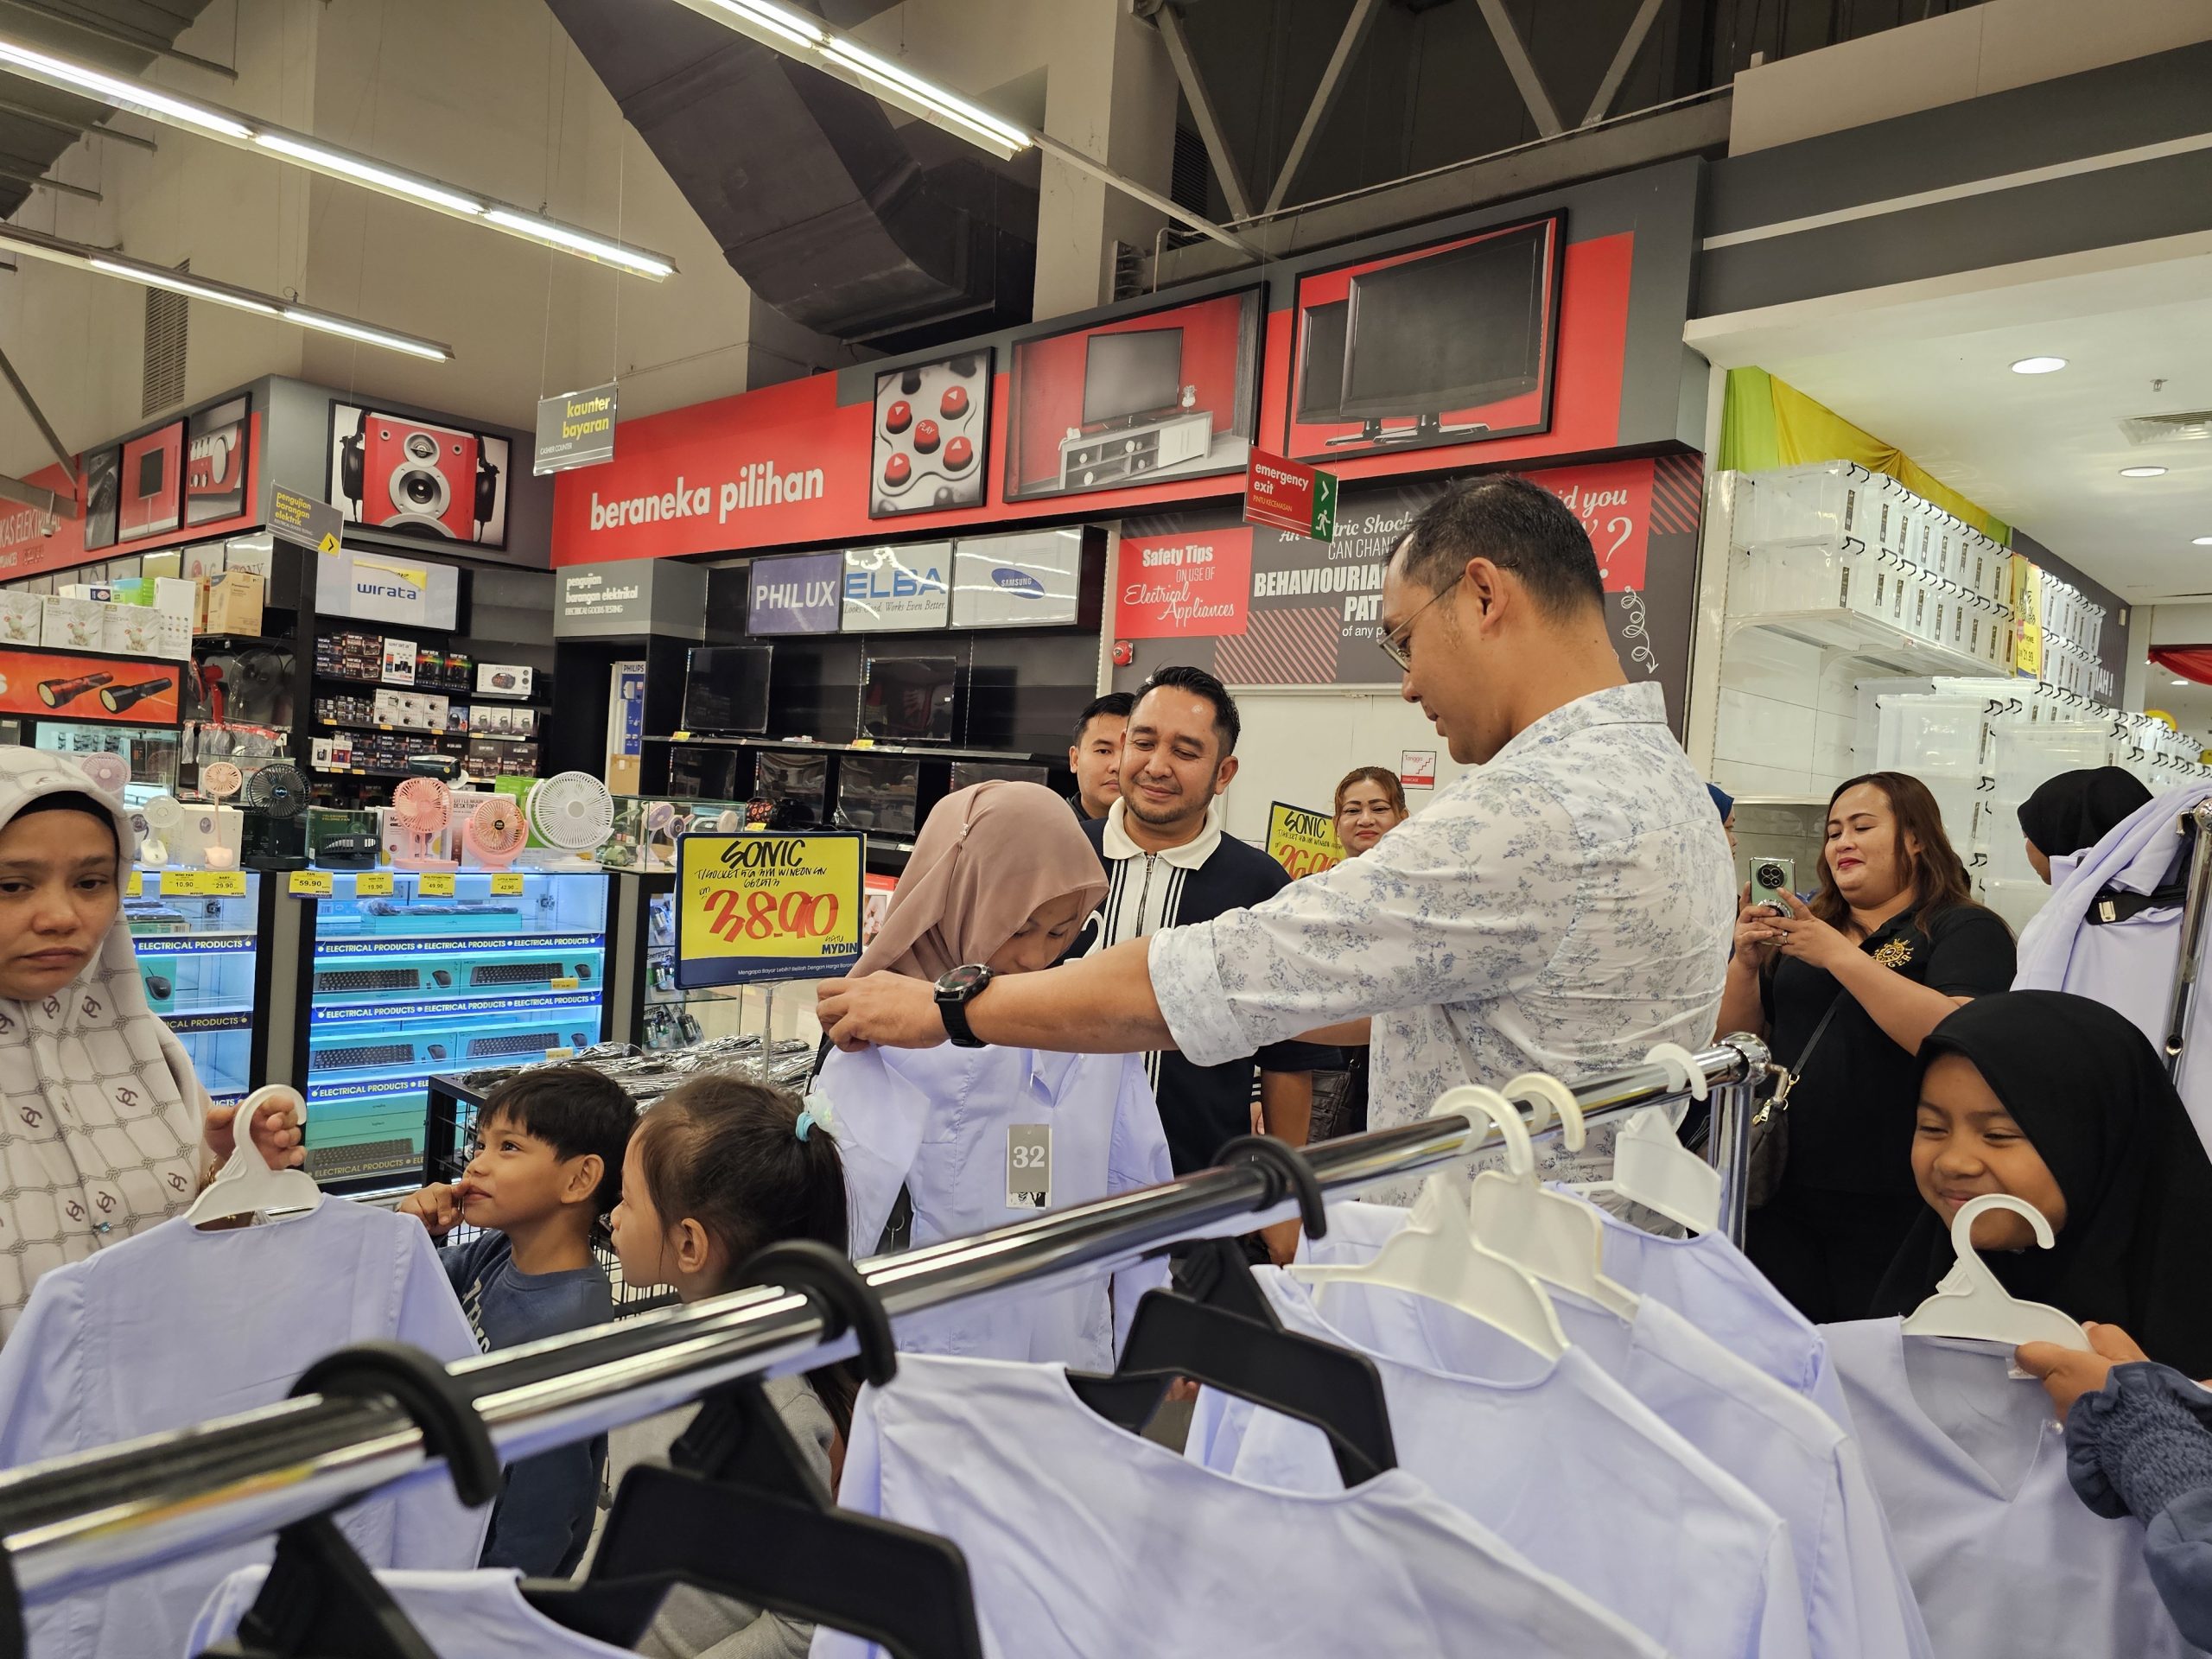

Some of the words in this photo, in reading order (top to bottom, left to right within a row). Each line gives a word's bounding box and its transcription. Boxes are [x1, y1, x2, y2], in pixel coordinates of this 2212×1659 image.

[567, 397, 610, 418] kaunter
[562, 418, 608, 441] bayaran
[556, 442, 572, 453] COUNTER
[1255, 463, 1309, 491] emergency
[590, 476, 711, 531] beraneka
[719, 461, 823, 524] pilihan
[1254, 480, 1274, 494] exit
[276, 492, 311, 511] pengujian
[276, 500, 309, 518] barangan
[1253, 495, 1266, 505] PINTU
[1265, 499, 1293, 512] KECEMASAN
[1582, 489, 1627, 518] you
[275, 511, 302, 526] elektrik
[1142, 548, 1184, 567] Safety
[1185, 544, 1213, 564] Tips
[1328, 541, 1352, 560] CAN
[567, 573, 602, 591] pengujian
[844, 568, 947, 599] ELBA
[1001, 576, 1032, 588] SAMSUNG
[1176, 569, 1187, 583] ON
[1188, 568, 1204, 582] USE
[1205, 566, 1216, 580] OF
[357, 583, 416, 601] wirata
[566, 592, 601, 605] barangan
[602, 585, 639, 601] elektrikal
[756, 581, 836, 610] PHILUX
[1124, 580, 1191, 605] Electrical
[844, 604, 861, 613] Looks
[886, 601, 905, 612] Works
[906, 601, 923, 611] Even
[924, 600, 946, 610] Better.
[1157, 597, 1235, 627] Appliances
[1344, 594, 1383, 622] PAT
[1342, 626, 1352, 637] of
[1355, 626, 1373, 639] any
[623, 664, 645, 673] PHILIPS
[1284, 810, 1326, 838] SONIC
[721, 839, 805, 869] SONIC
[703, 889, 839, 943] 38.90
[138, 941, 193, 950] ELECTRICAL
[195, 940, 243, 949] PRODUCTS
[326, 944, 372, 953] ELECTRICAL
[424, 941, 467, 950] ELECTRICAL
[822, 942, 858, 955] MYDIN
[646, 949, 670, 961] Energizer
[326, 1008, 372, 1019] ELECTRICAL
[374, 1007, 415, 1016] PRODUCTS
[424, 1003, 467, 1013] ELECTRICAL
[468, 1001, 505, 1010] PRODUCTS
[644, 1004, 661, 1016] ergizer
[191, 1017, 238, 1027] PRODUCTS
[320, 1085, 365, 1097] ELECTRICAL
[367, 1082, 408, 1092] PRODUCTS
[418, 1080, 429, 1089] ELE
[213, 1098, 235, 1107] UCTS
[1013, 1145, 1046, 1168] 32
[315, 1164, 360, 1178] ELECTRICAL
[363, 1160, 404, 1172] PRODUCTS
